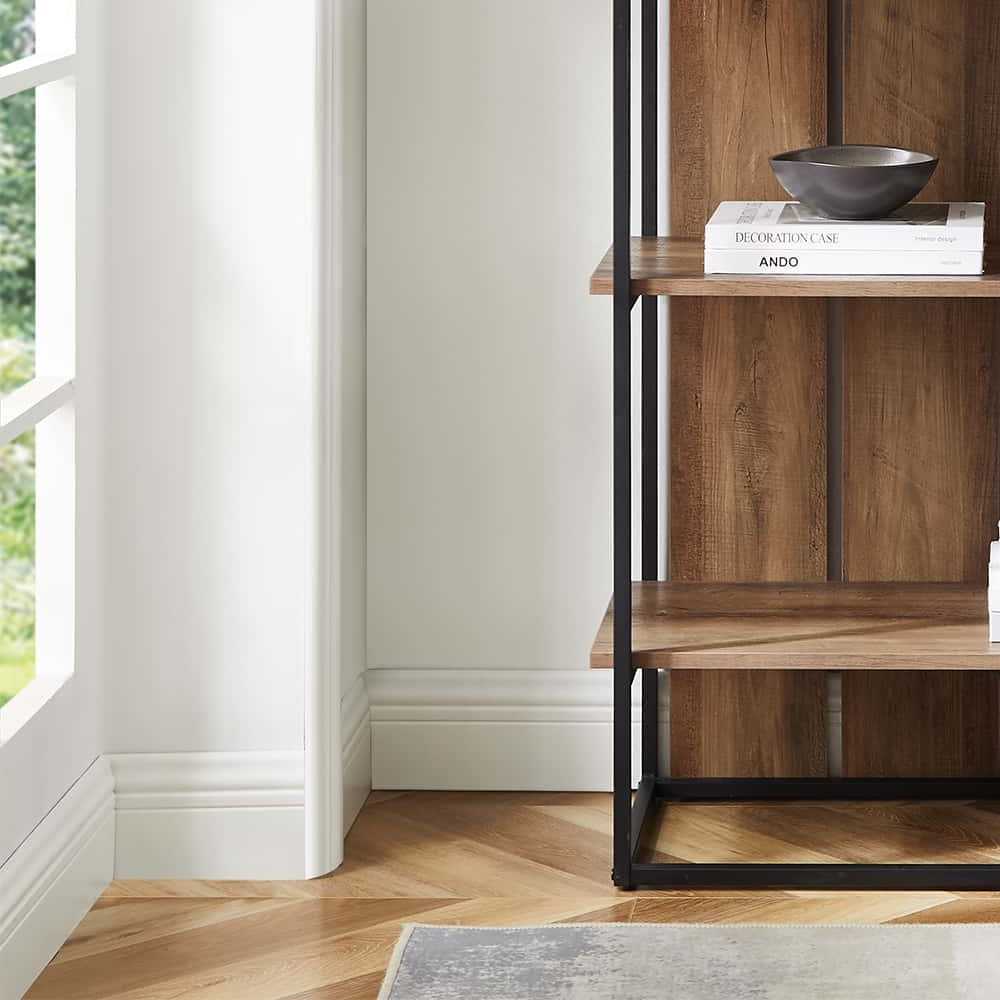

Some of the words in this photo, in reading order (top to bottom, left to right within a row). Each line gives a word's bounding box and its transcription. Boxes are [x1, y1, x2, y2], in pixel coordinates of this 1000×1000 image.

[735, 231, 808, 243] DECORATION
[810, 232, 840, 244] CASE
[759, 256, 799, 268] ANDO
